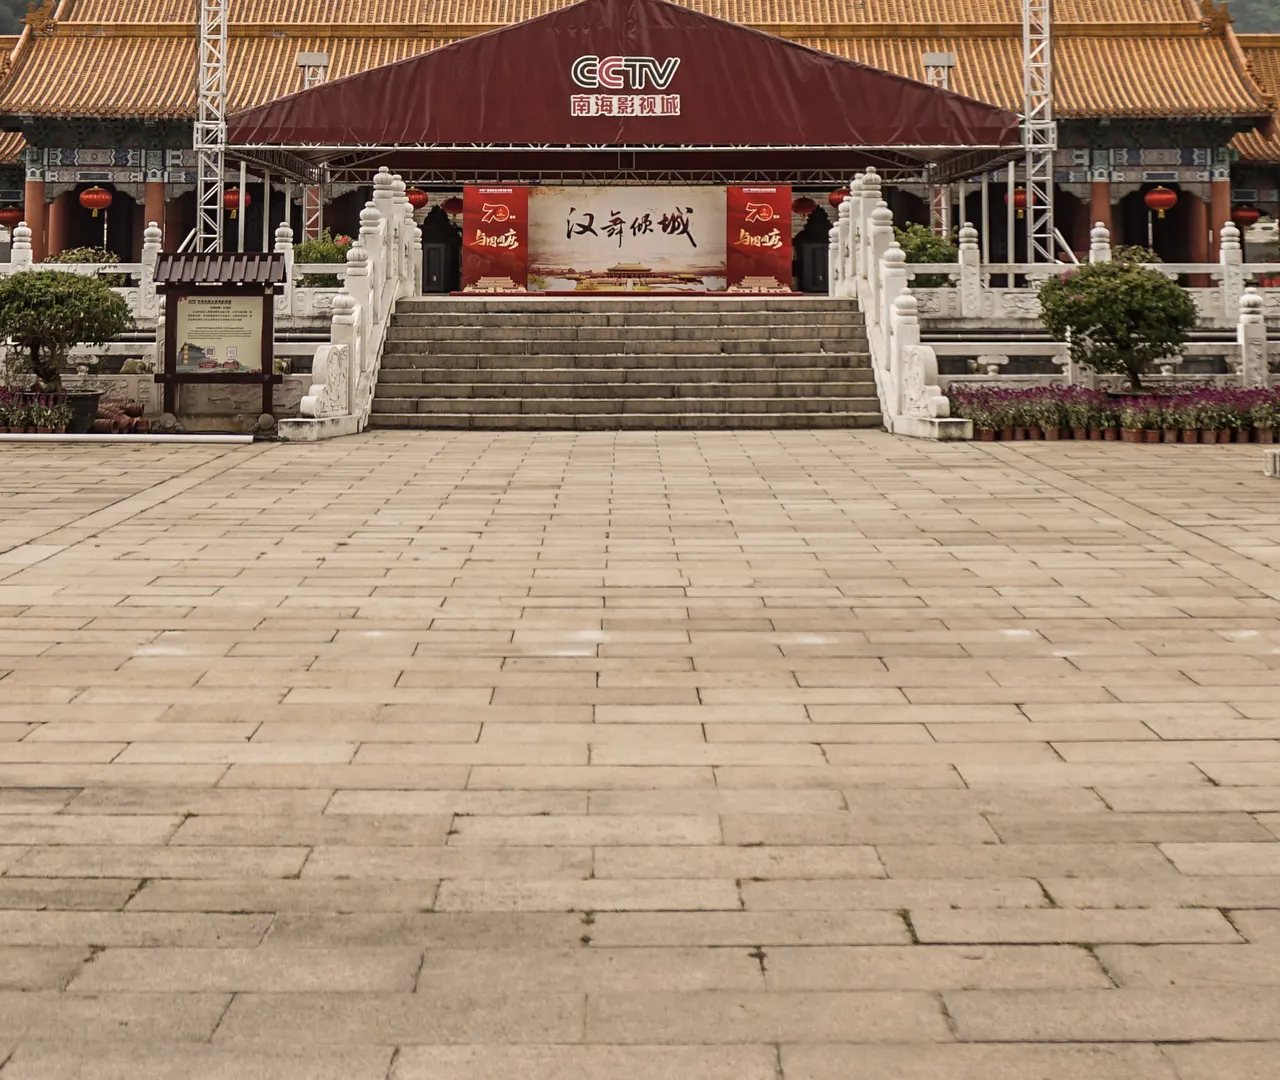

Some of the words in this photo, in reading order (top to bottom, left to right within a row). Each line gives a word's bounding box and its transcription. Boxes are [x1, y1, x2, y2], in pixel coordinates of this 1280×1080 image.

[571, 55, 680, 89] CCTV
[570, 94, 681, 116] 南海影视城
[481, 202, 510, 224] 70
[745, 201, 774, 223] 70
[566, 206, 697, 248] 汉舞倾城
